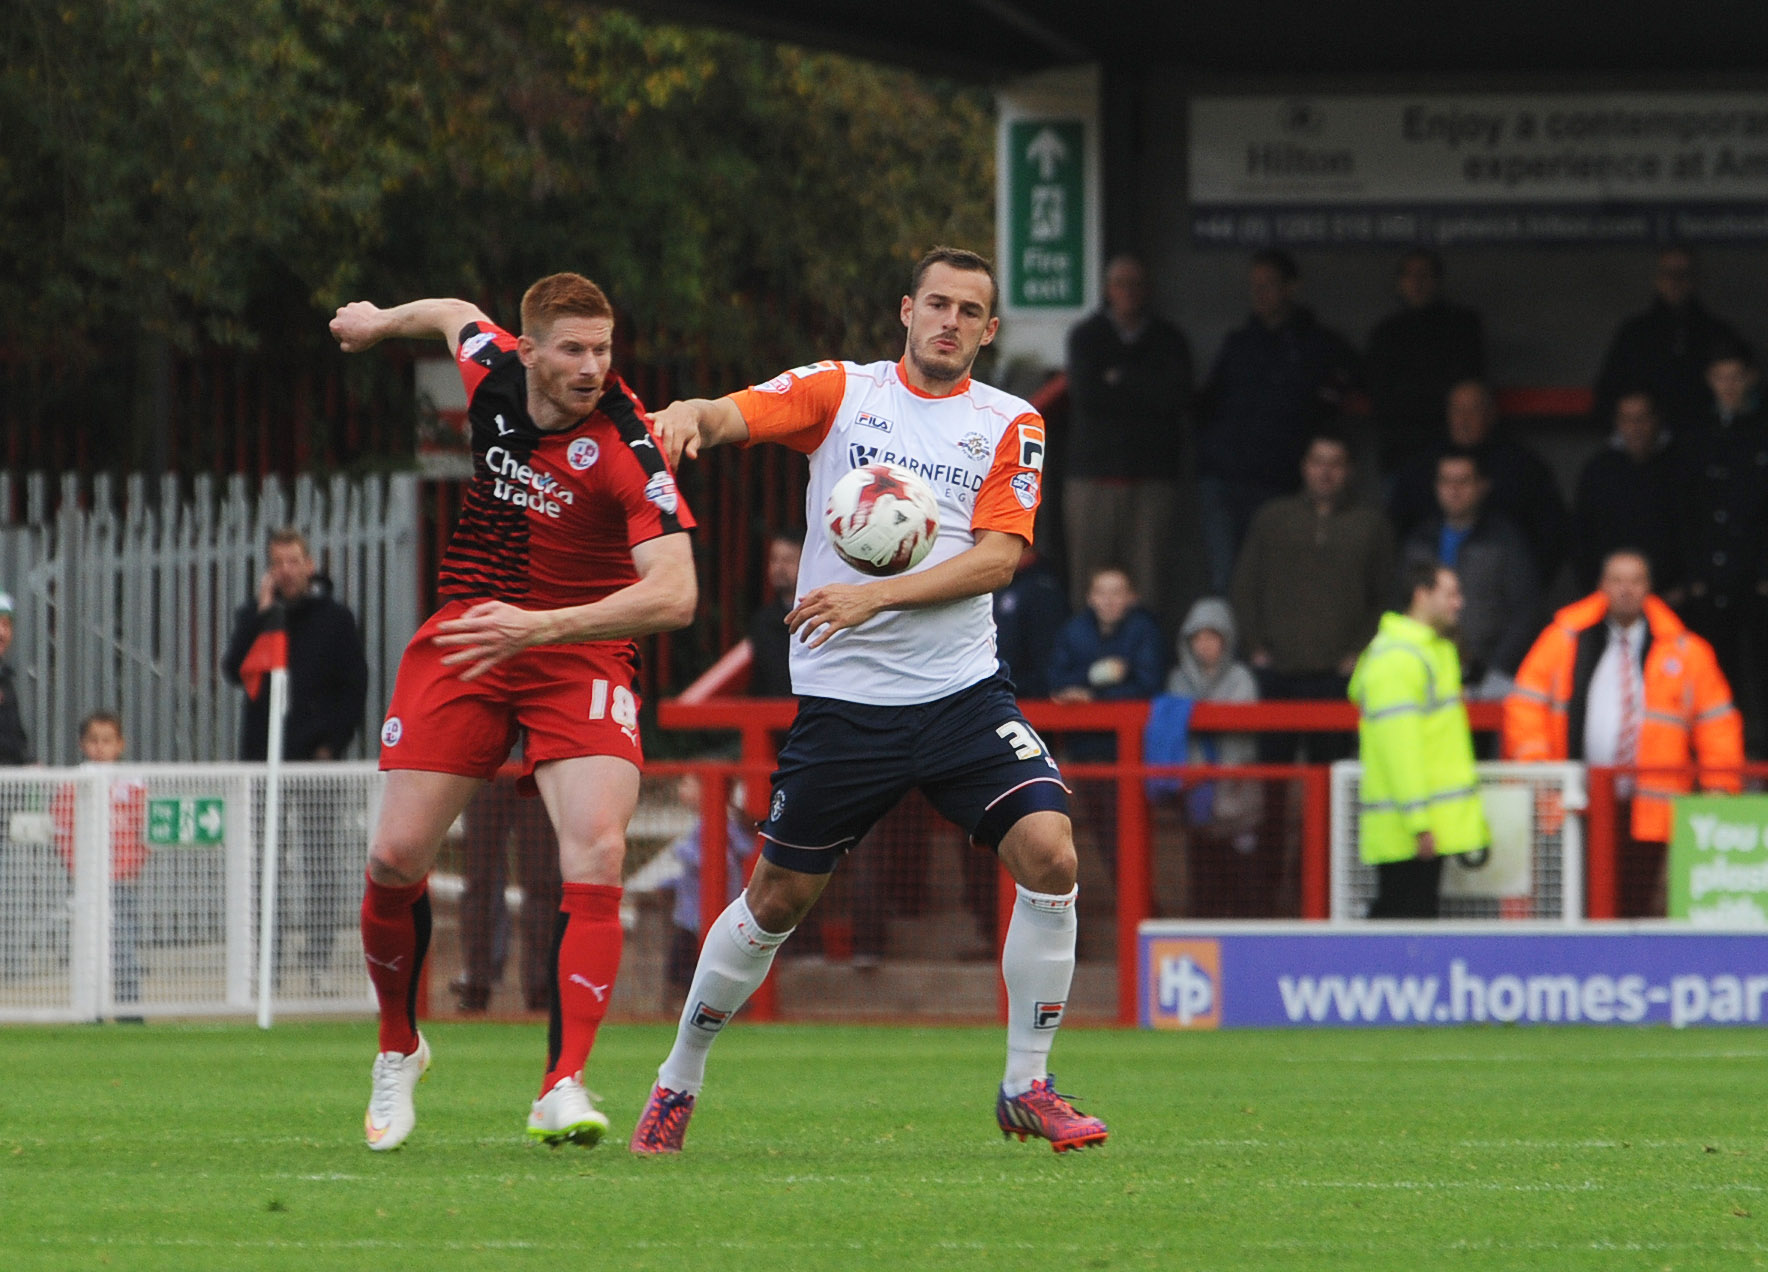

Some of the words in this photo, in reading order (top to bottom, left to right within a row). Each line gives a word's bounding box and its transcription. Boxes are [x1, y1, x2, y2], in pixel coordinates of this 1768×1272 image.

[1401, 104, 1505, 148] Enjoy
[1515, 112, 1537, 141] a
[1246, 141, 1355, 174] Hilton
[1462, 150, 1661, 186] experience
[1670, 150, 1704, 180] at
[1023, 248, 1070, 273] Fire
[1023, 277, 1071, 299] exit
[859, 413, 888, 430] FILA
[883, 451, 984, 492] BARNFIELD
[493, 477, 561, 518] trade
[589, 679, 638, 730] 18
[995, 720, 1051, 760] 3
[1689, 813, 1758, 852] You
